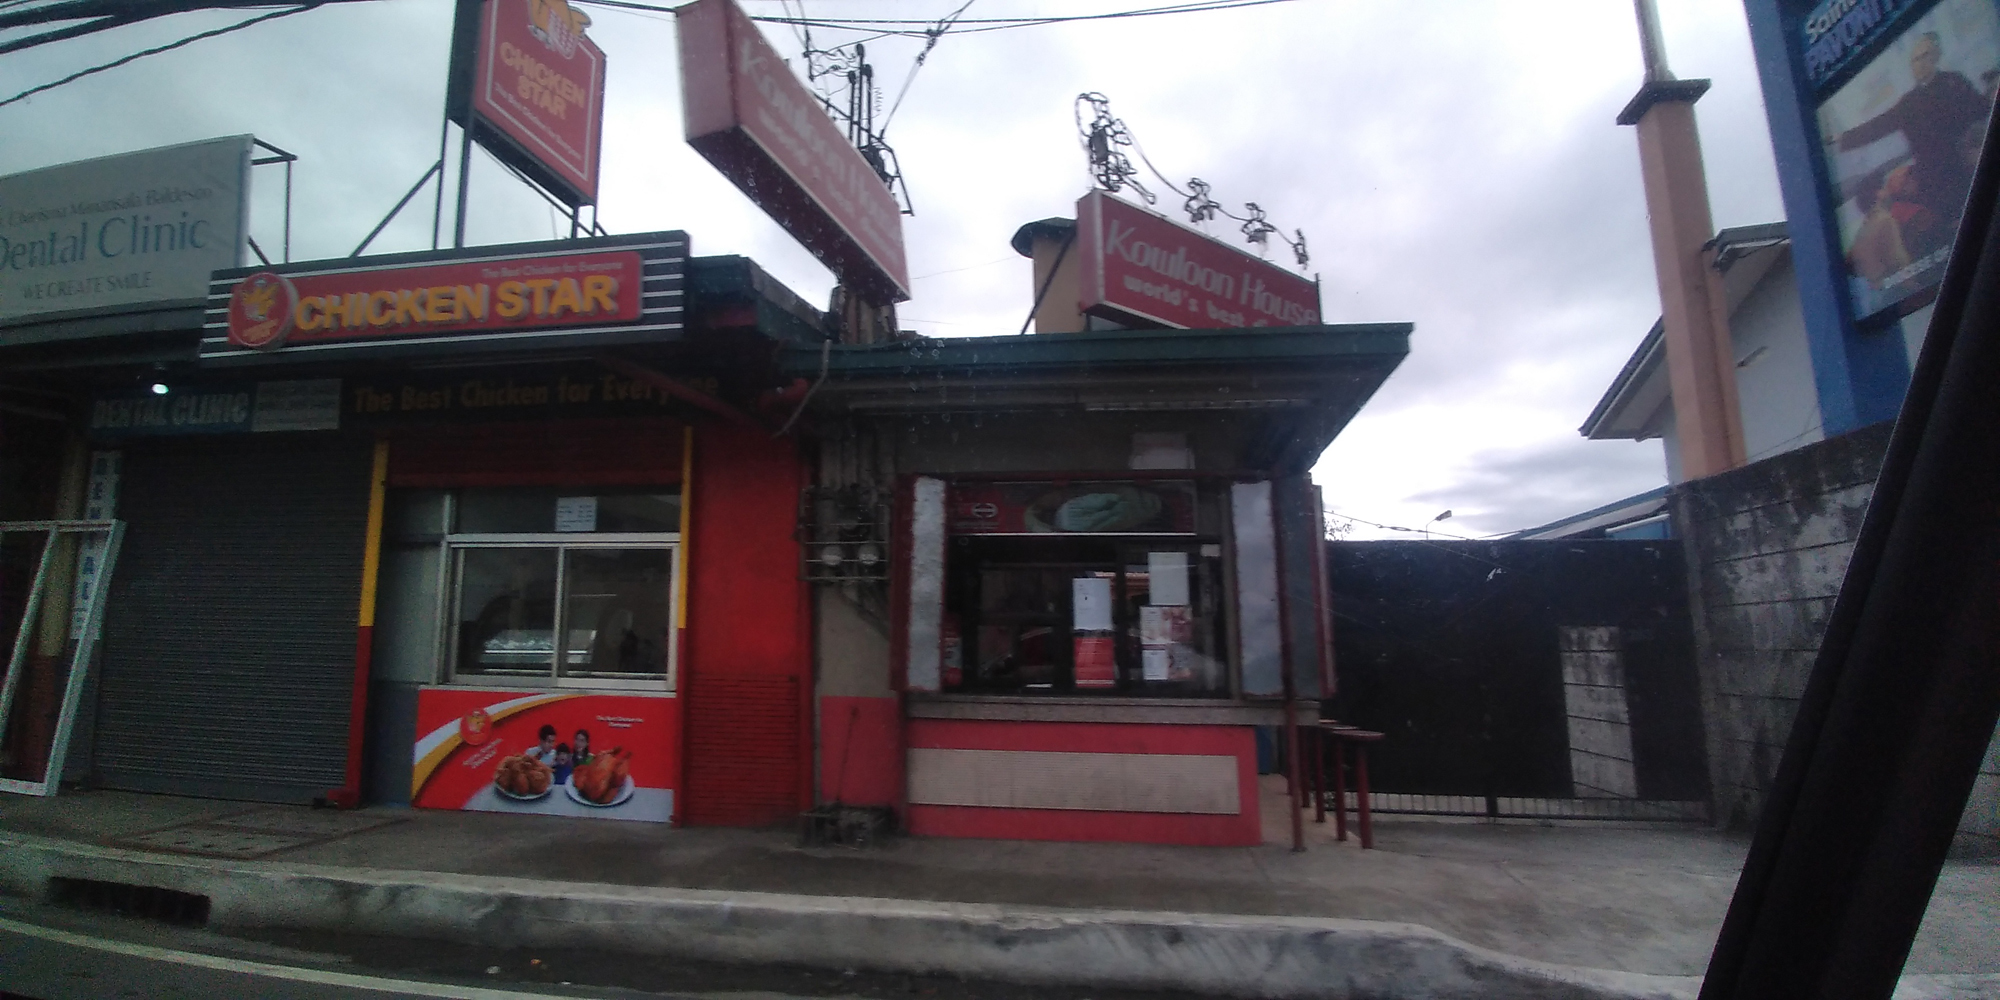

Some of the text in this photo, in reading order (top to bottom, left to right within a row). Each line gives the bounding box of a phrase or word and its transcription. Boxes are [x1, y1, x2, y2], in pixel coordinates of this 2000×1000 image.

[500, 41, 586, 109] CHICKEN
[517, 75, 567, 120] STAR
[0, 220, 88, 271] Dental
[97, 210, 211, 259] Clinic
[23, 271, 152, 300] WE CREATE SMILE
[1106, 219, 1318, 325] Kowloon House
[298, 283, 490, 333] CHICKEN
[496, 274, 620, 320] STAR
[92, 397, 170, 430] DENTAL
[171, 391, 250, 427] CLINIC
[355, 388, 395, 413] The
[400, 385, 451, 412] Best
[460, 379, 549, 408] Chicken
[557, 374, 594, 404] for
[602, 372, 720, 407] Everyne
